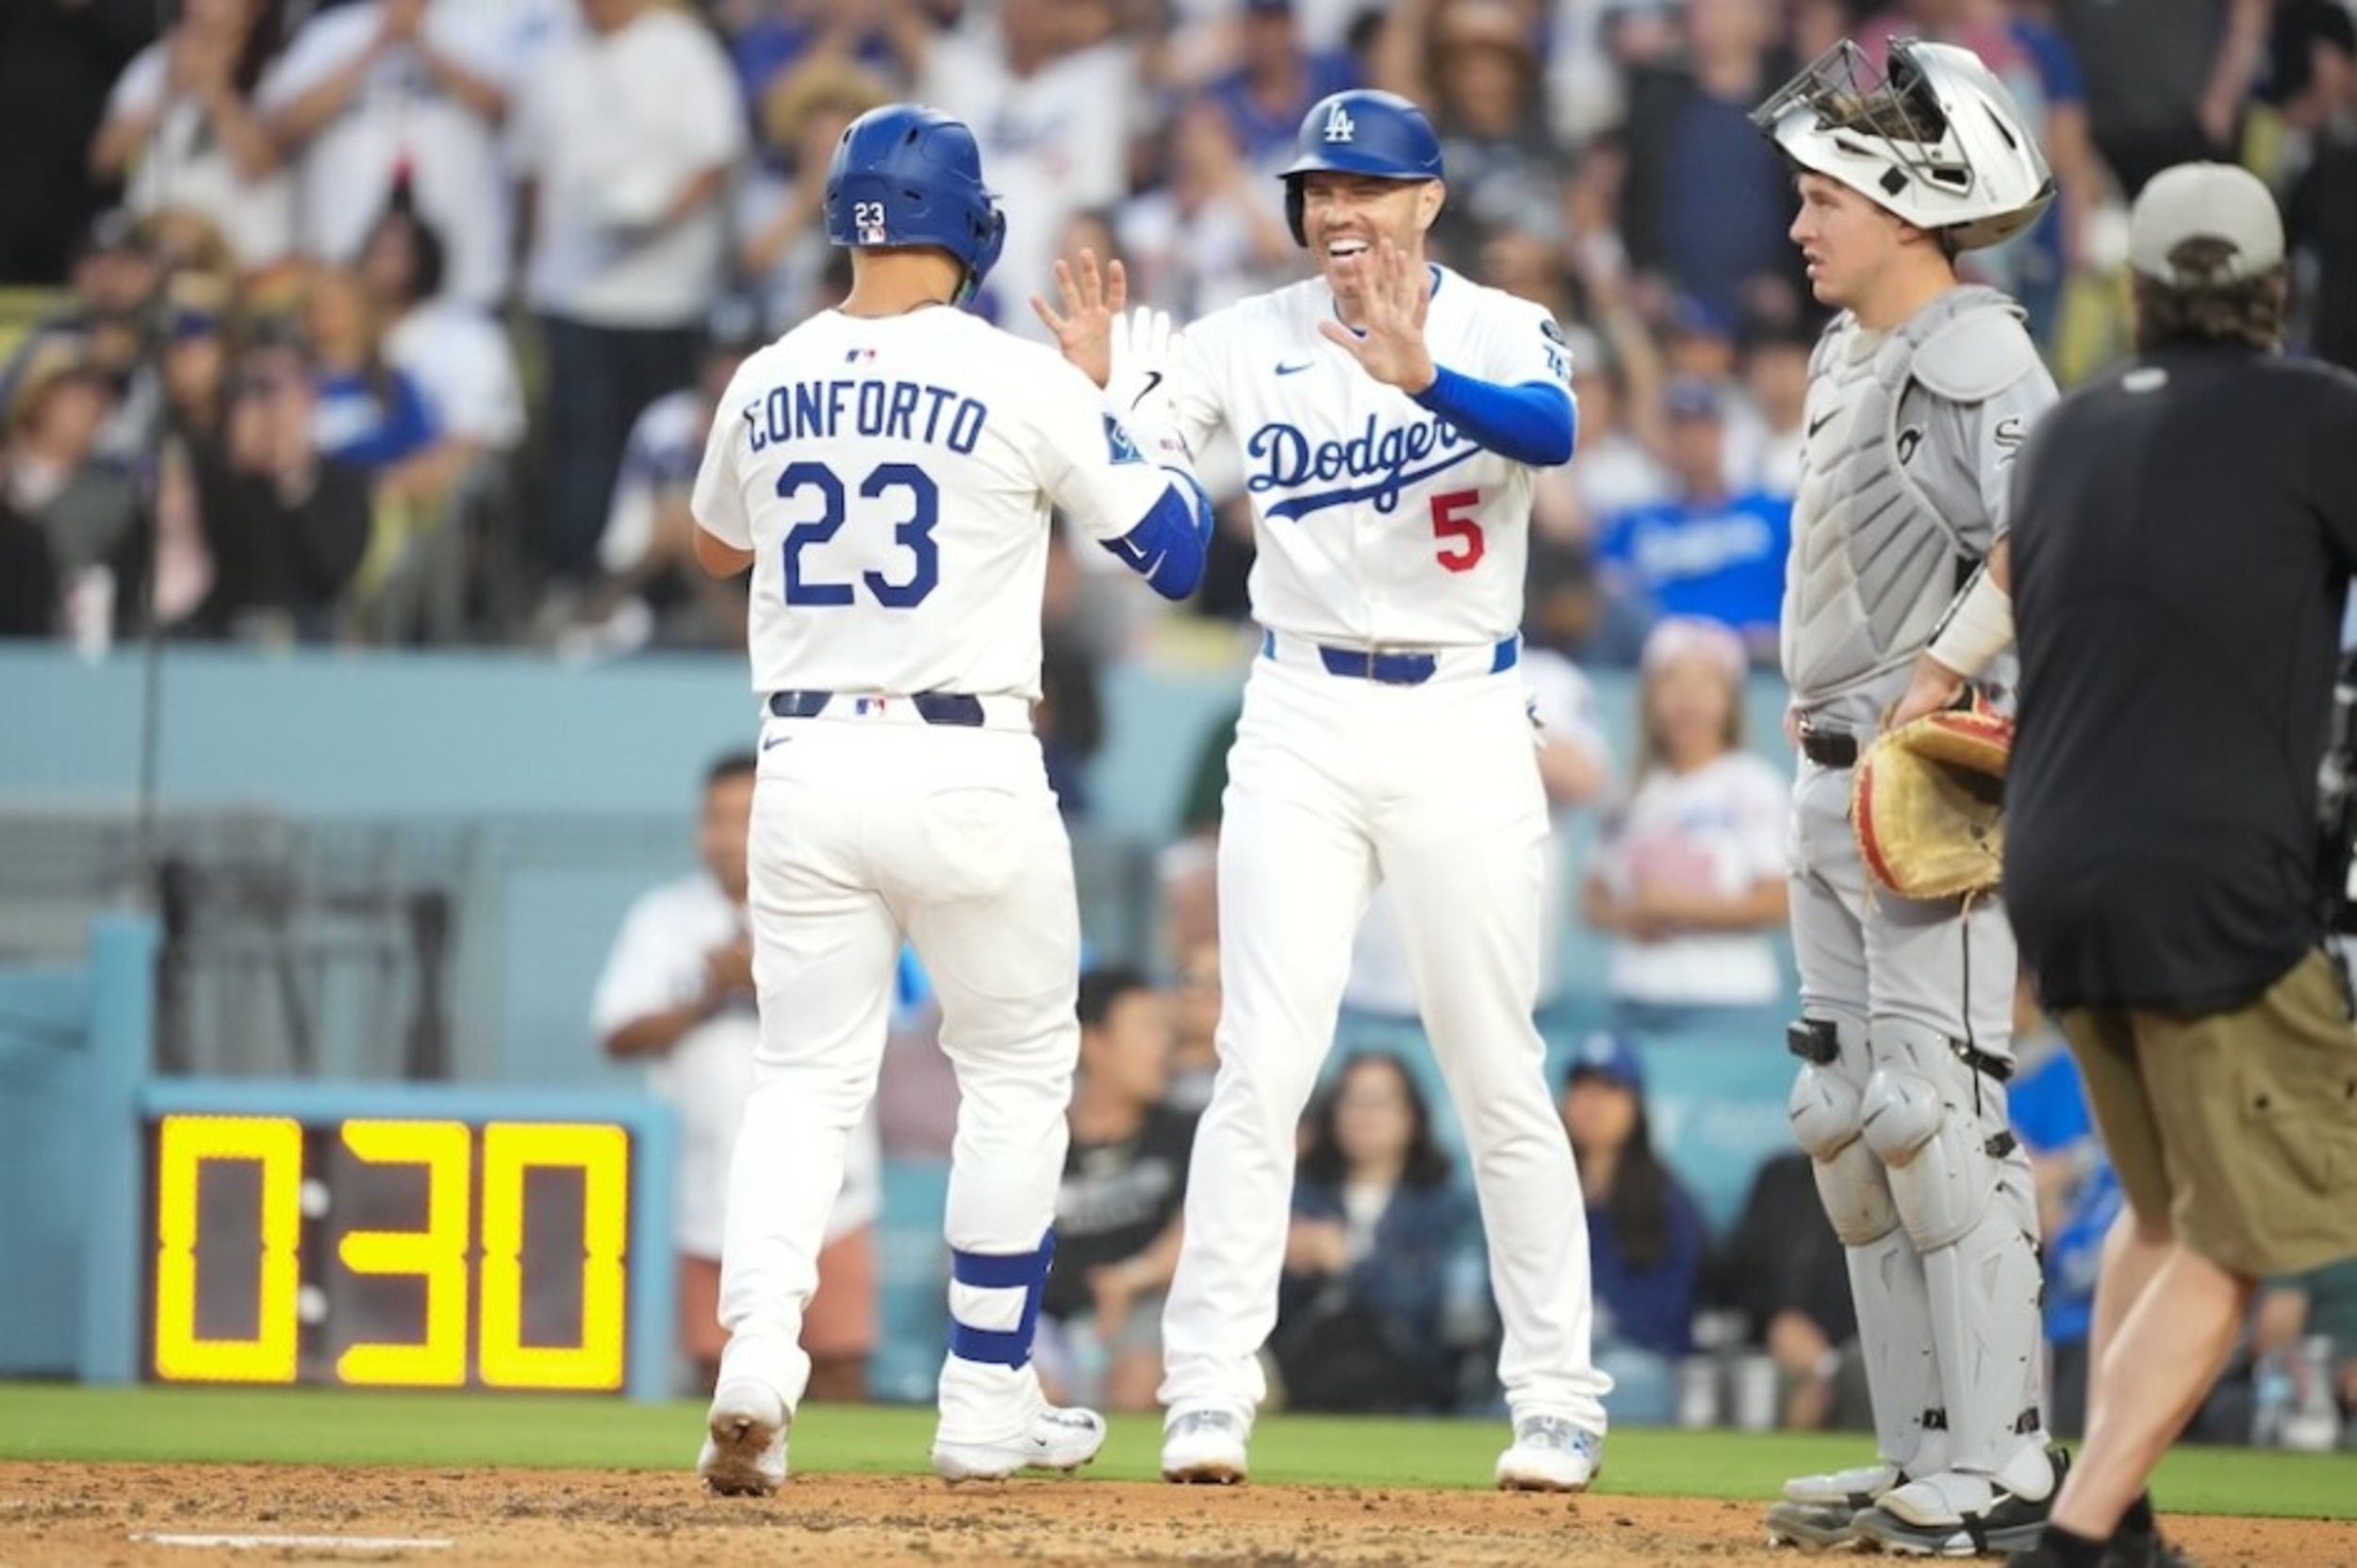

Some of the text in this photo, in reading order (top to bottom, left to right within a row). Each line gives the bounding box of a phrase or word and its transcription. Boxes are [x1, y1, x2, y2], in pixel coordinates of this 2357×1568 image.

[1325, 101, 1355, 141] LA
[853, 202, 884, 227] 23
[743, 380, 988, 454] CONFORTO
[1247, 413, 1462, 514] Dodger
[776, 461, 939, 608] 23
[1430, 488, 1485, 572] 5
